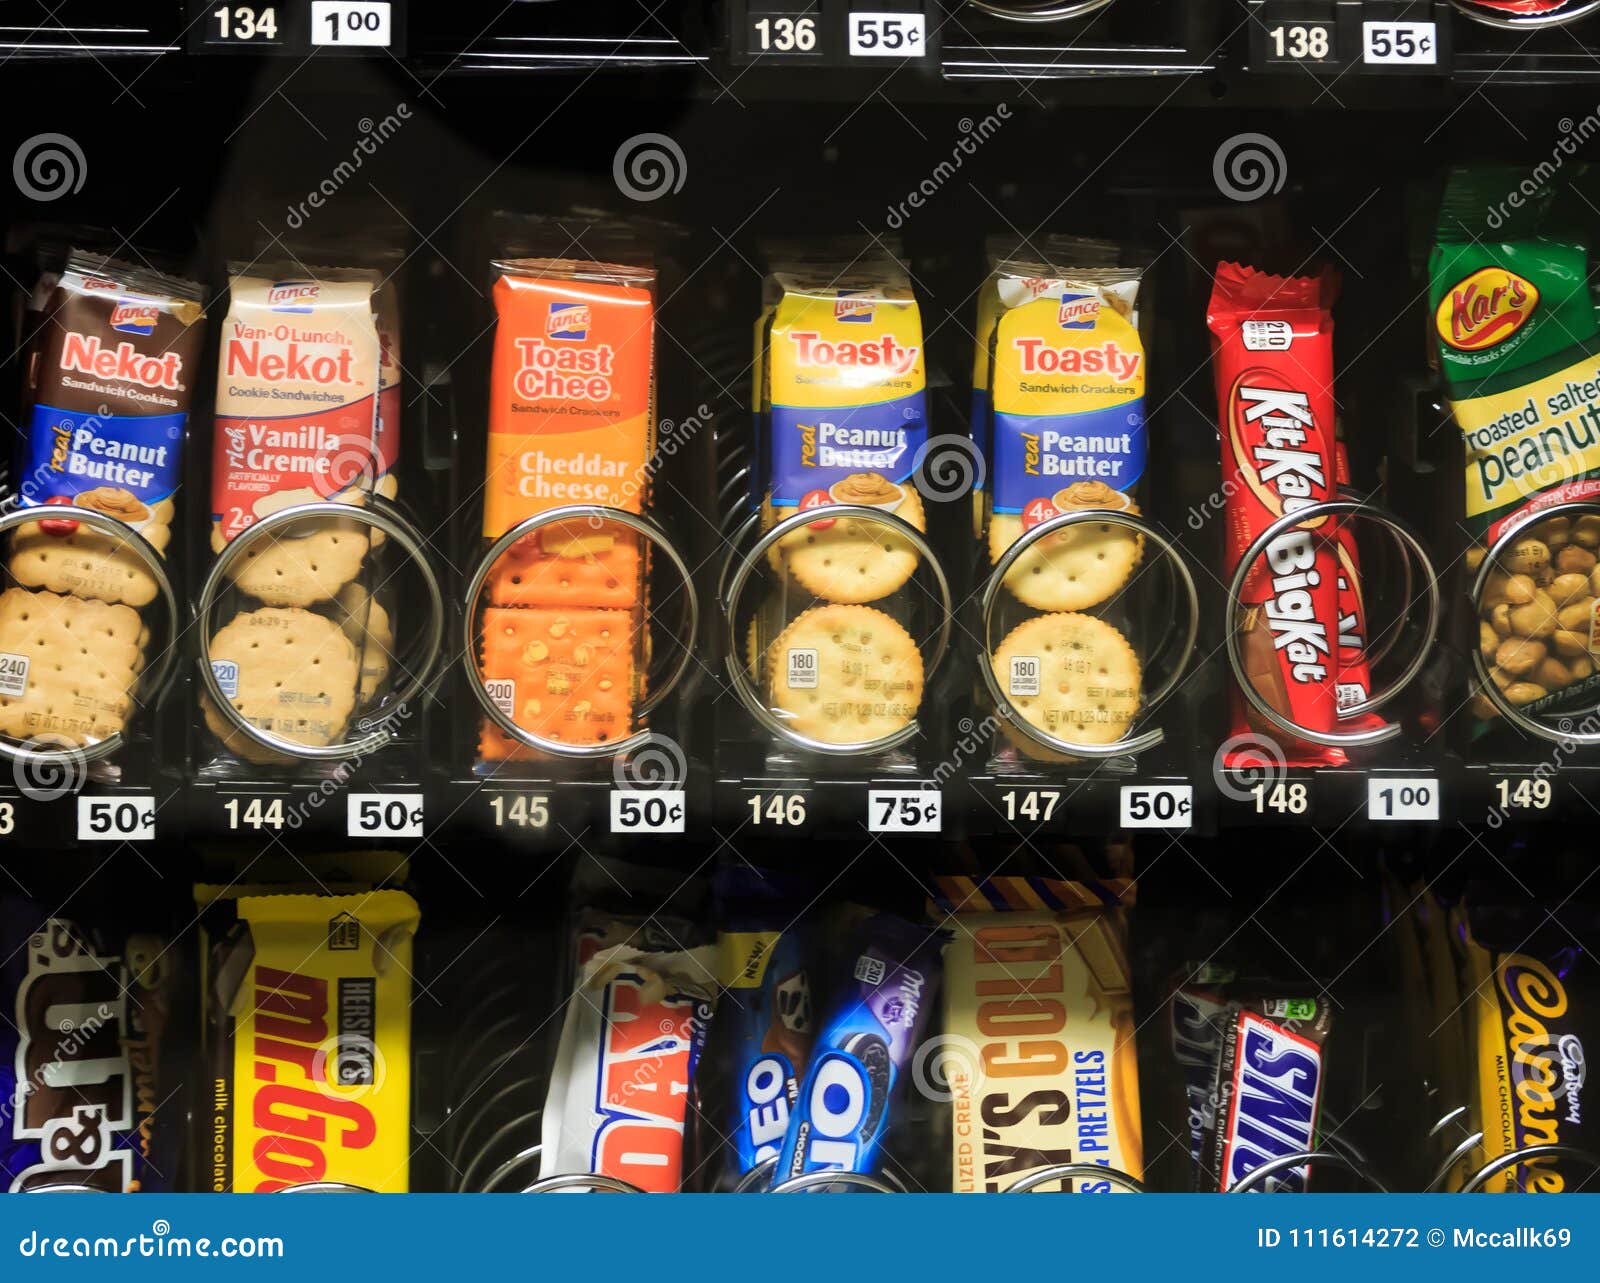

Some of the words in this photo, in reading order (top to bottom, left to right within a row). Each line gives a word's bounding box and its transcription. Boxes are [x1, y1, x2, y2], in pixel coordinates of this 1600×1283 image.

[214, 7, 278, 40] 134
[755, 18, 817, 51] 136
[857, 20, 920, 49] 55¢
[1270, 26, 1329, 58] 138
[1371, 29, 1432, 57] 55¢
[110, 303, 160, 326] Lance
[546, 311, 590, 334] Lance
[1057, 302, 1101, 324] Lance
[1450, 274, 1529, 340] Kar's
[1267, 322, 1286, 345] 210
[61, 331, 184, 390] Nekot
[227, 340, 353, 384] Nekot
[517, 340, 612, 374] Toast
[790, 332, 919, 375] Toasty
[1016, 339, 1140, 382] Toasty
[61, 376, 127, 399] Sandwich
[127, 388, 178, 407] Cookies
[228, 386, 270, 398] Cookie
[271, 388, 345, 403] Sandwiches
[516, 368, 610, 400] Chee
[1019, 382, 1079, 394] Sandwich
[1080, 384, 1136, 395] Crackers
[511, 403, 568, 415] Sandwich
[1466, 399, 1540, 451] roasted
[1547, 369, 1600, 416] salted
[51, 425, 72, 473] real
[73, 428, 168, 468] Peanut
[225, 426, 247, 469] rich
[249, 424, 341, 451] Vanilla
[796, 423, 817, 467] real
[819, 422, 907, 447] Peanut
[1042, 430, 1131, 454] Peanut
[247, 449, 331, 474] Creme
[519, 450, 630, 477] Cheddar
[819, 446, 897, 469] Butter
[1023, 432, 1041, 477] real
[1042, 454, 1124, 478] Butter
[1477, 402, 1600, 500] peanut
[68, 452, 155, 489] Butter
[518, 475, 610, 501] Cheese
[1264, 530, 1330, 682] BigKat
[0, 658, 26, 676] 240
[791, 654, 814, 670] 180
[1013, 661, 1035, 677] 180
[487, 684, 512, 699] 200
[747, 794, 806, 826] 146
[1002, 791, 1061, 821] 147
[1129, 790, 1192, 821] 50¢
[1250, 783, 1308, 814] 148
[1495, 779, 1552, 810] 149
[89, 801, 155, 834] 50¢
[224, 798, 285, 830] 144
[359, 799, 423, 832] 50¢
[489, 796, 550, 827] 145
[619, 797, 683, 828] 50¢
[875, 796, 938, 827] 75¢
[865, 960, 884, 984] 230
[974, 924, 1070, 1079] GOLD
[341, 982, 372, 1080] HERSHEY'S
[1495, 1054, 1506, 1082] MILK
[1558, 1034, 1584, 1125] Cadbury
[214, 1078, 229, 1112] milk
[955, 1072, 972, 1137] CREME
[1073, 1050, 1109, 1152] PRETZELS
[213, 1114, 226, 1193] chocolate
